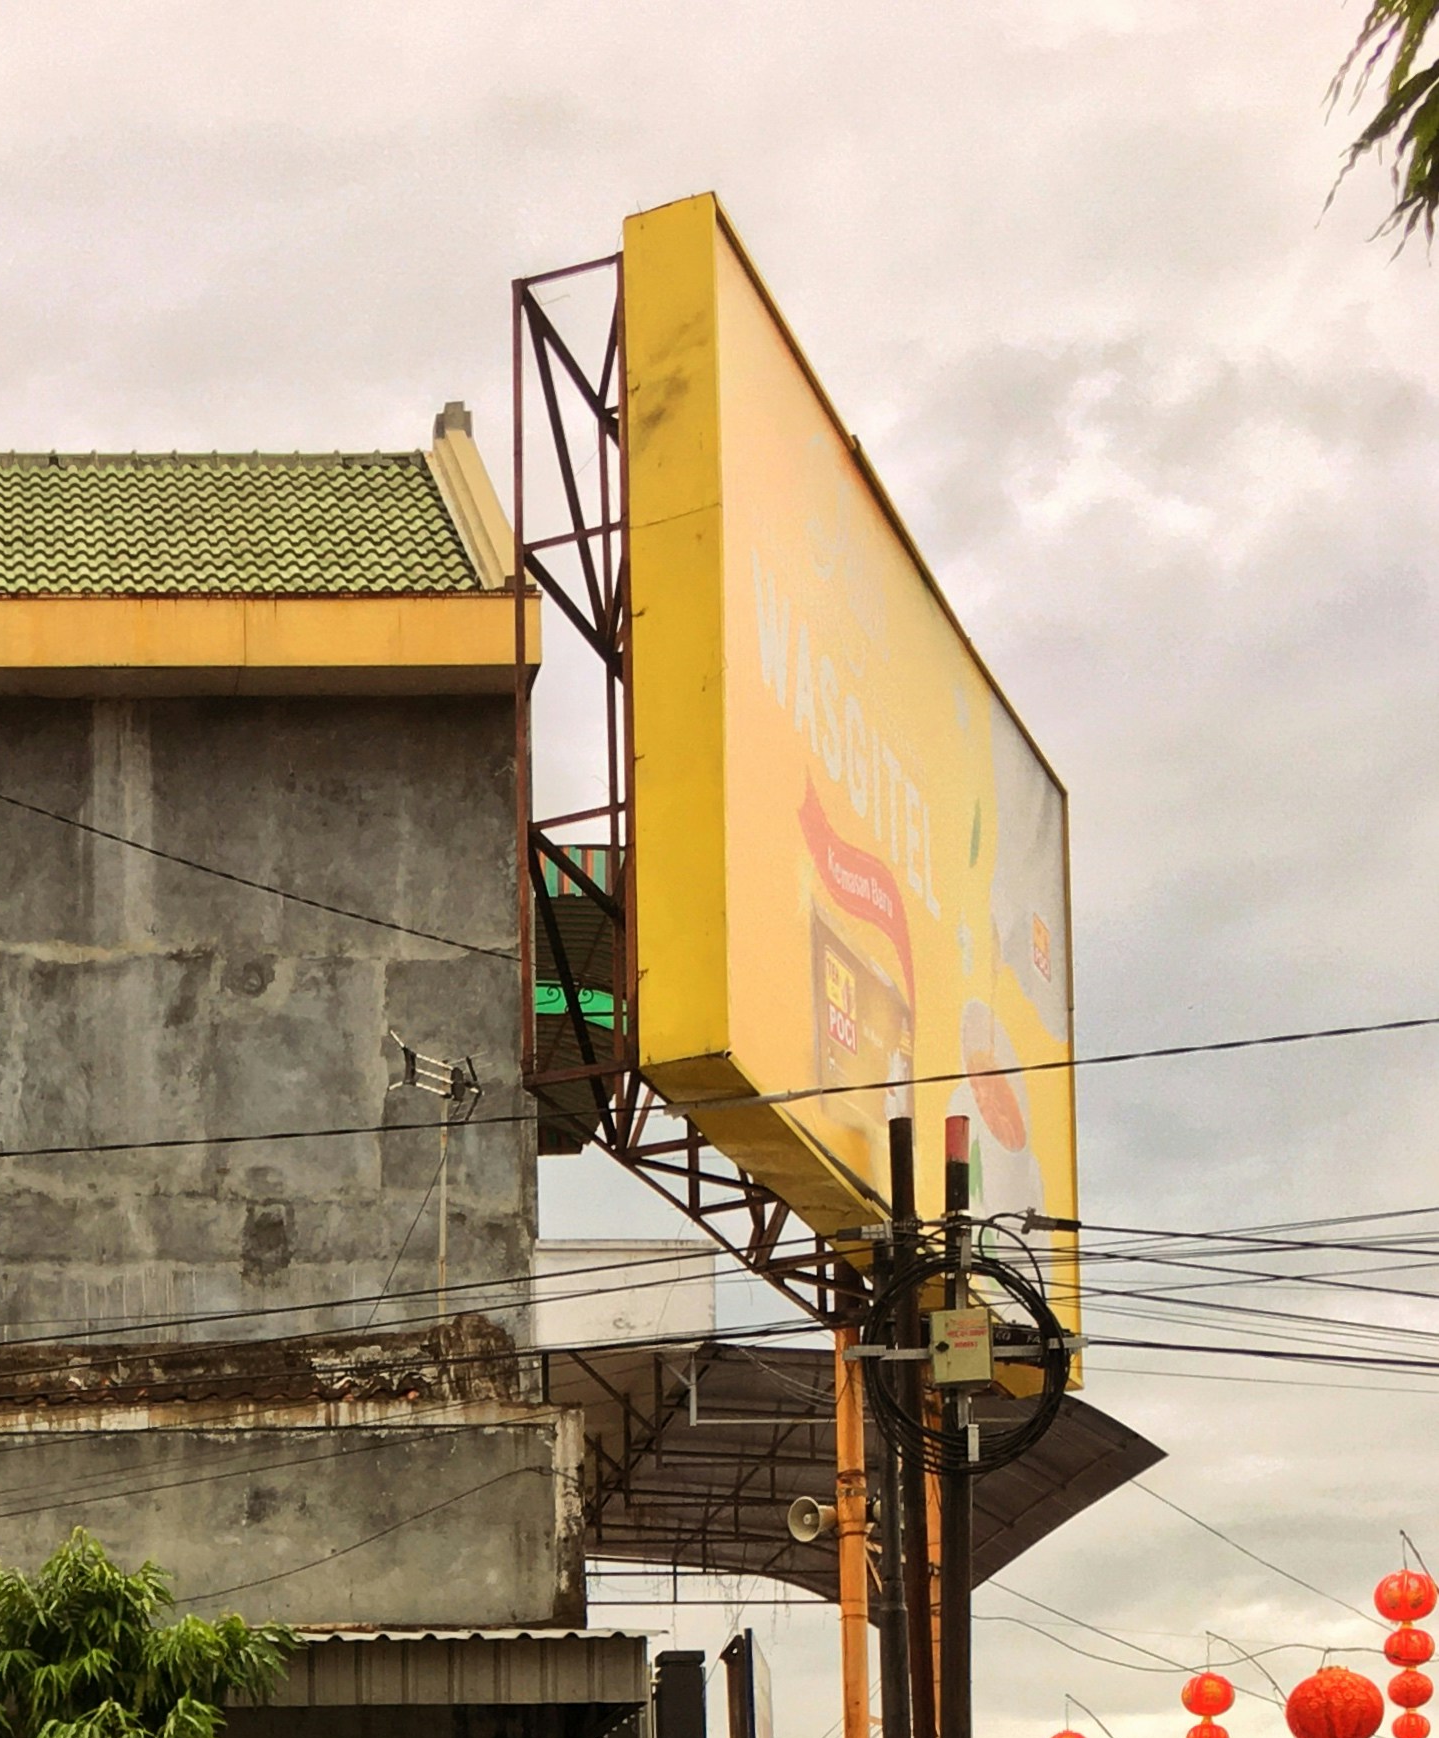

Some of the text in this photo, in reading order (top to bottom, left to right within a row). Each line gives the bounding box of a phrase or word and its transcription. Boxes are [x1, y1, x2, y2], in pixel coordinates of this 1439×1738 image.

[752, 546, 940, 921] WASGITEL
[827, 846, 893, 918] Kemasan Baru
[828, 1002, 856, 1051] POCI
